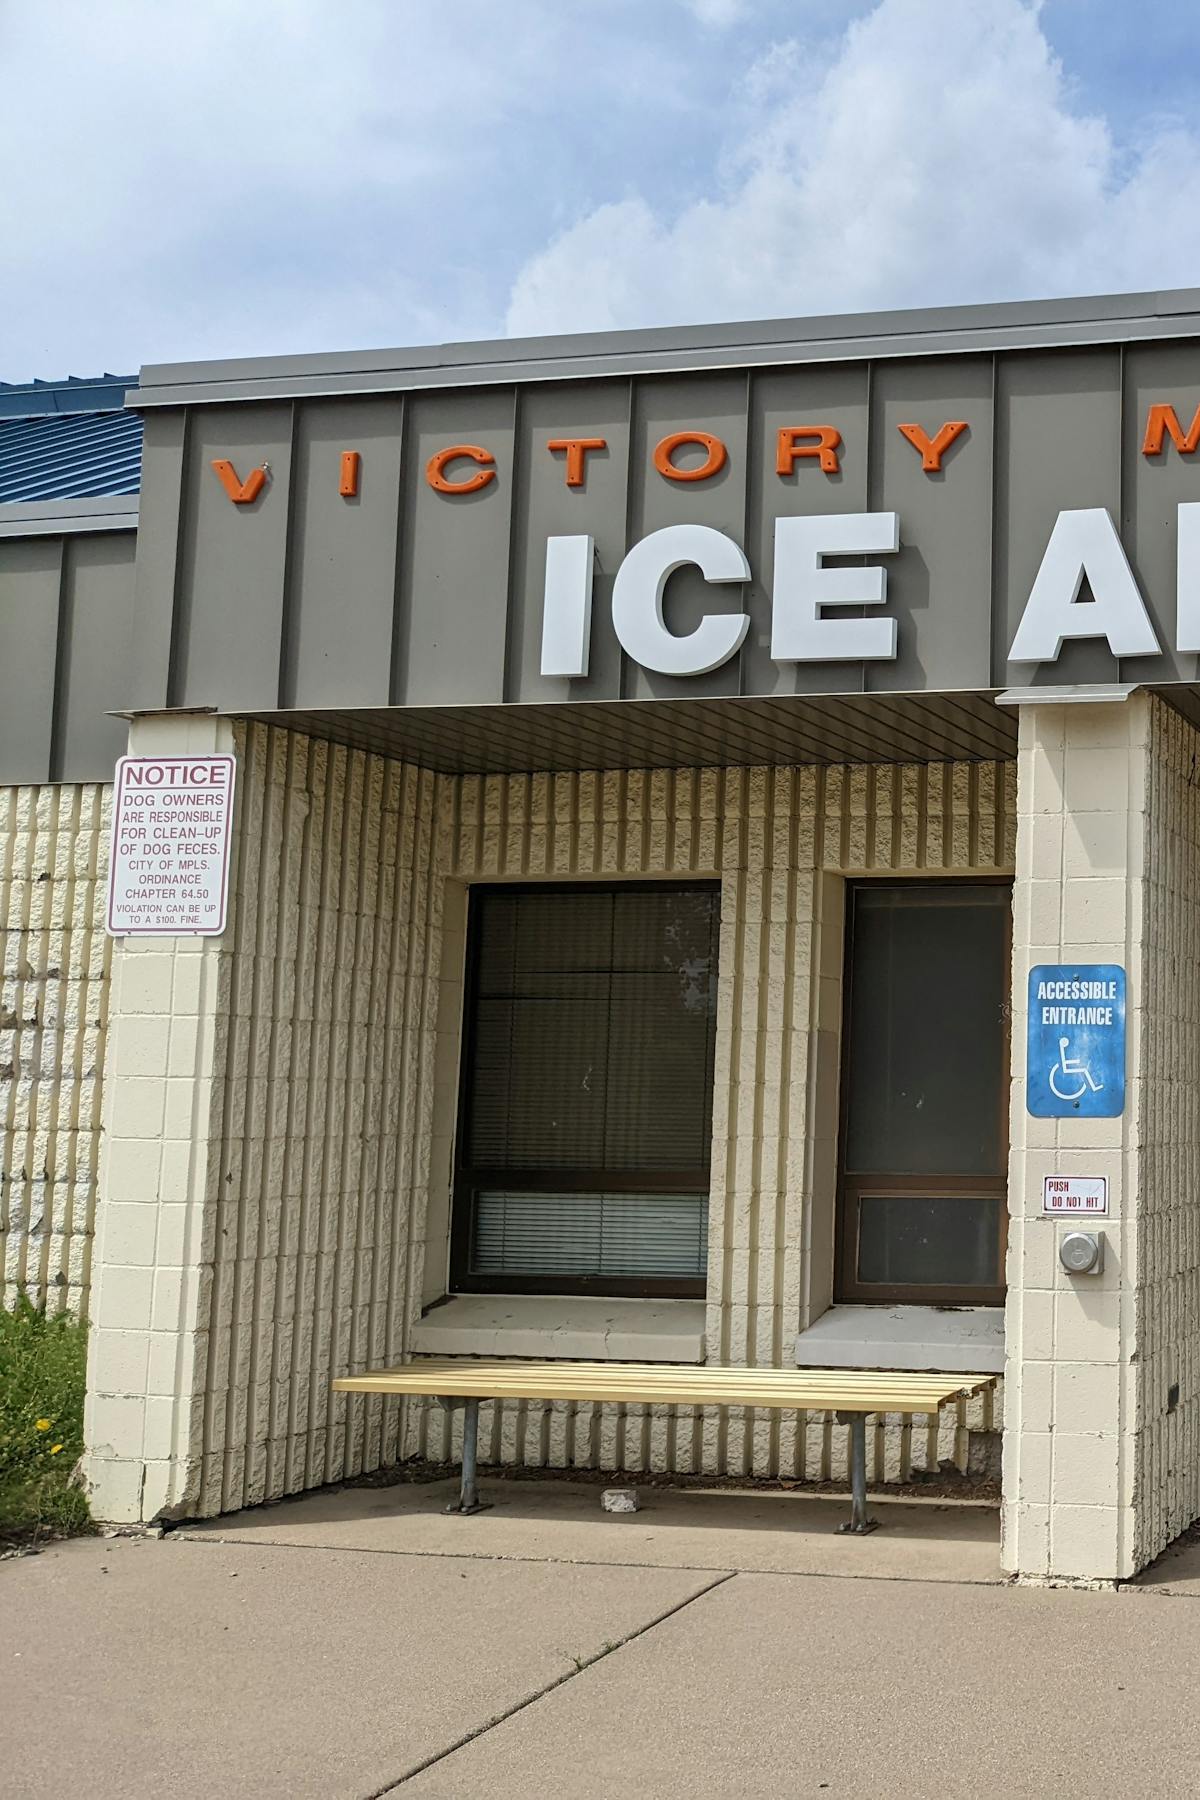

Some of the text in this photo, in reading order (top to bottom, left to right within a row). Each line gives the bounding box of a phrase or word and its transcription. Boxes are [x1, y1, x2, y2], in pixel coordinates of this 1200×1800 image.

[211, 420, 968, 505] VICTORY
[541, 512, 900, 678] ICE
[125, 765, 226, 785] NOTICE
[123, 794, 224, 807] DOG OWNERS
[122, 811, 223, 823] ARE RESPONSIBLE
[121, 827, 222, 839] FOR CLEAN-UP
[120, 843, 221, 855] OF DOG FECES.
[128, 860, 210, 870] CITY OF MPLS.
[138, 874, 201, 885] ORDINANCE
[125, 889, 209, 899] CHAPTER 64.50
[116, 904, 217, 913] VIOLATION CAN BE UP
[129, 916, 141, 924] TO
[180, 916, 202, 924] FINE.
[1037, 981, 1116, 1000] ACCESSIBLE
[1042, 1007, 1112, 1026] ENTRANCE
[1048, 1181, 1069, 1192] PUSH
[1052, 1196, 1099, 1208] DO NOT HIT
